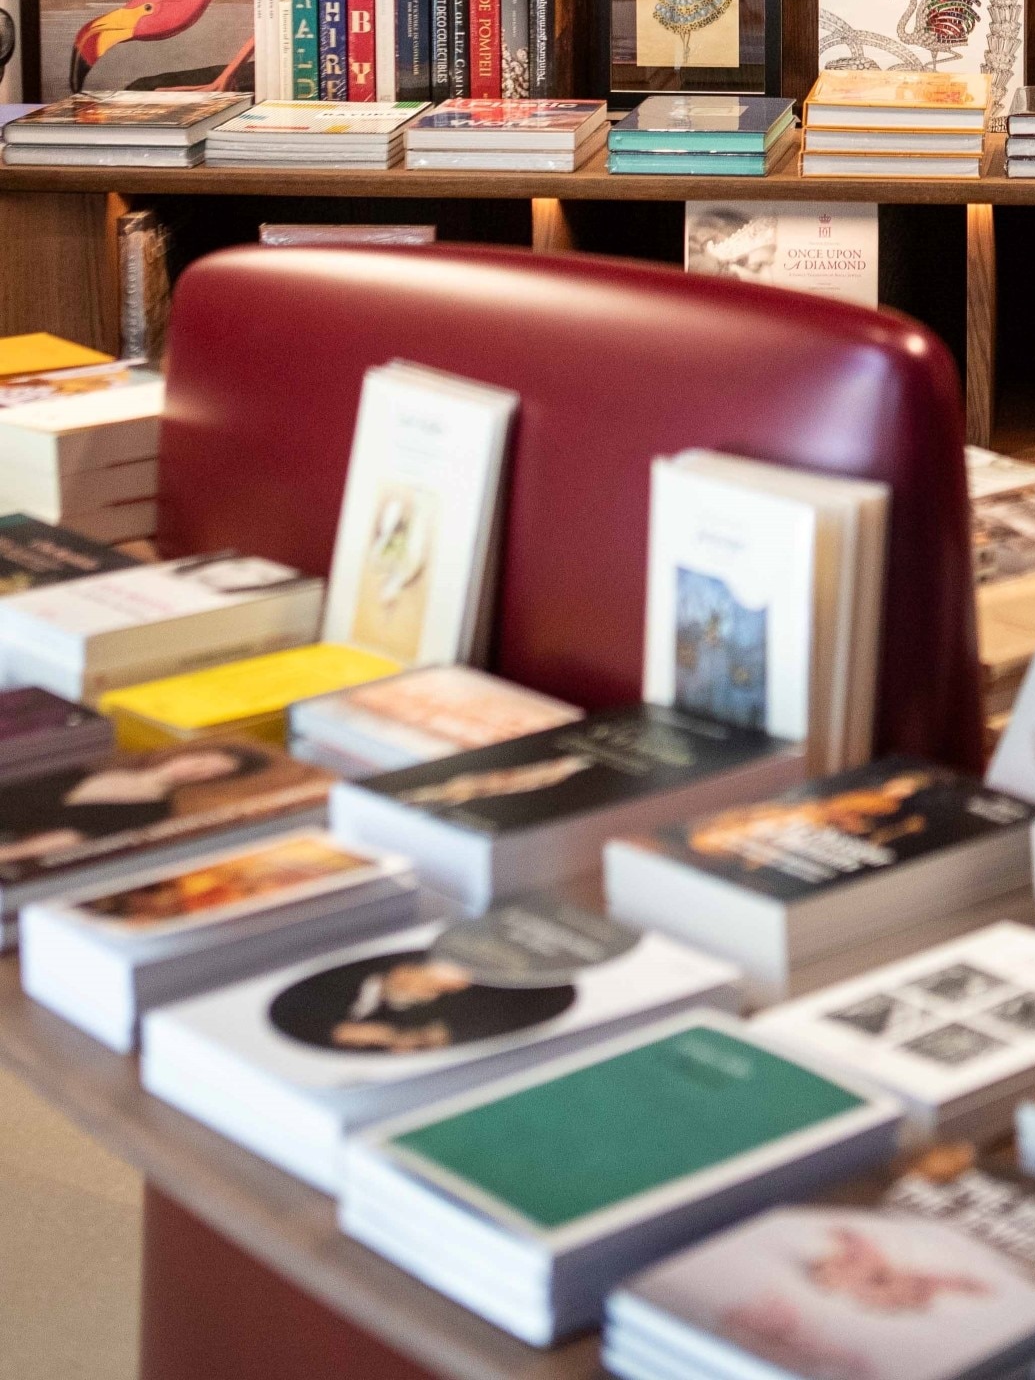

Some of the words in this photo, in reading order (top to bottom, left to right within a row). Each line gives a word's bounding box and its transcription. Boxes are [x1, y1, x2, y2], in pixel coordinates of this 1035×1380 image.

[479, 18, 492, 77] POMPEII
[788, 249, 825, 259] ONCE
[827, 249, 862, 259] UPON
[804, 260, 866, 270] DIAMOND
